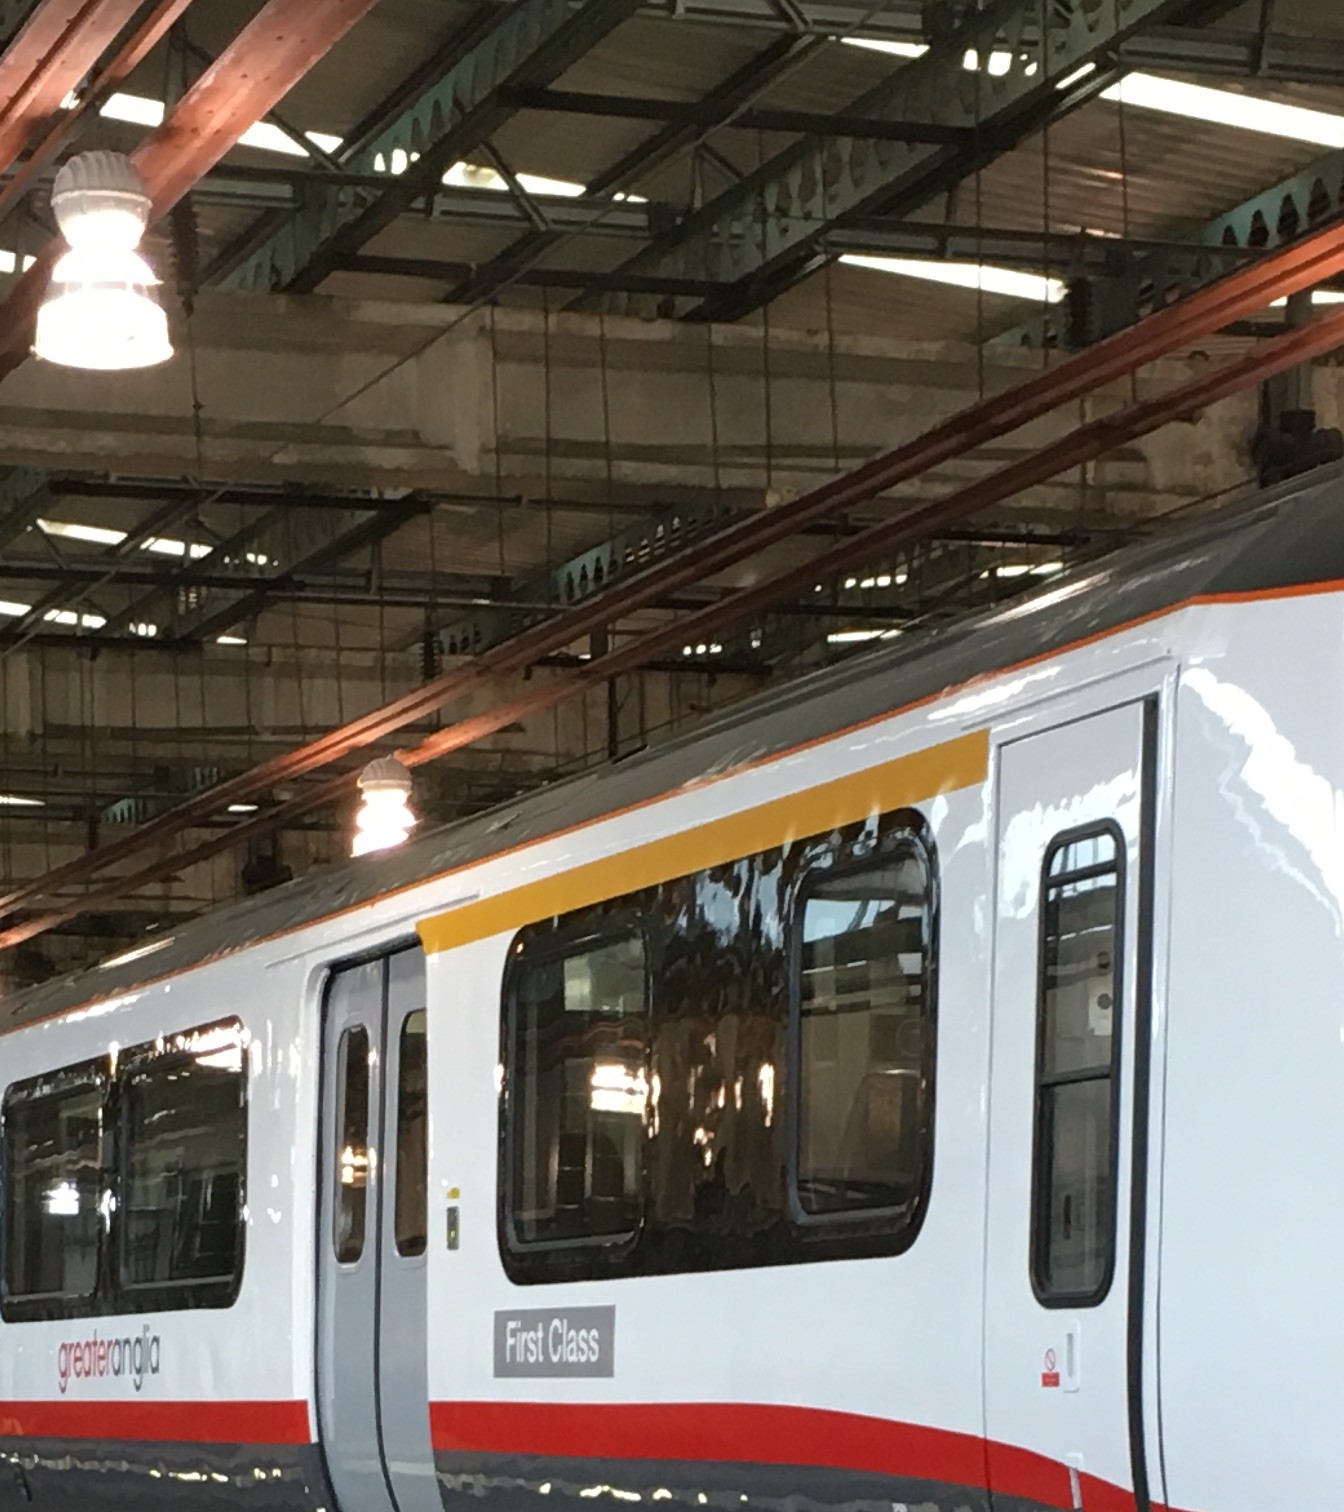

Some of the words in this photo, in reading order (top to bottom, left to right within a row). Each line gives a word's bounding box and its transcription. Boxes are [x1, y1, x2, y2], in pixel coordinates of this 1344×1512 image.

[58, 1324, 160, 1393] greateranglia
[506, 1321, 544, 1363] First
[548, 1318, 599, 1363] Class
